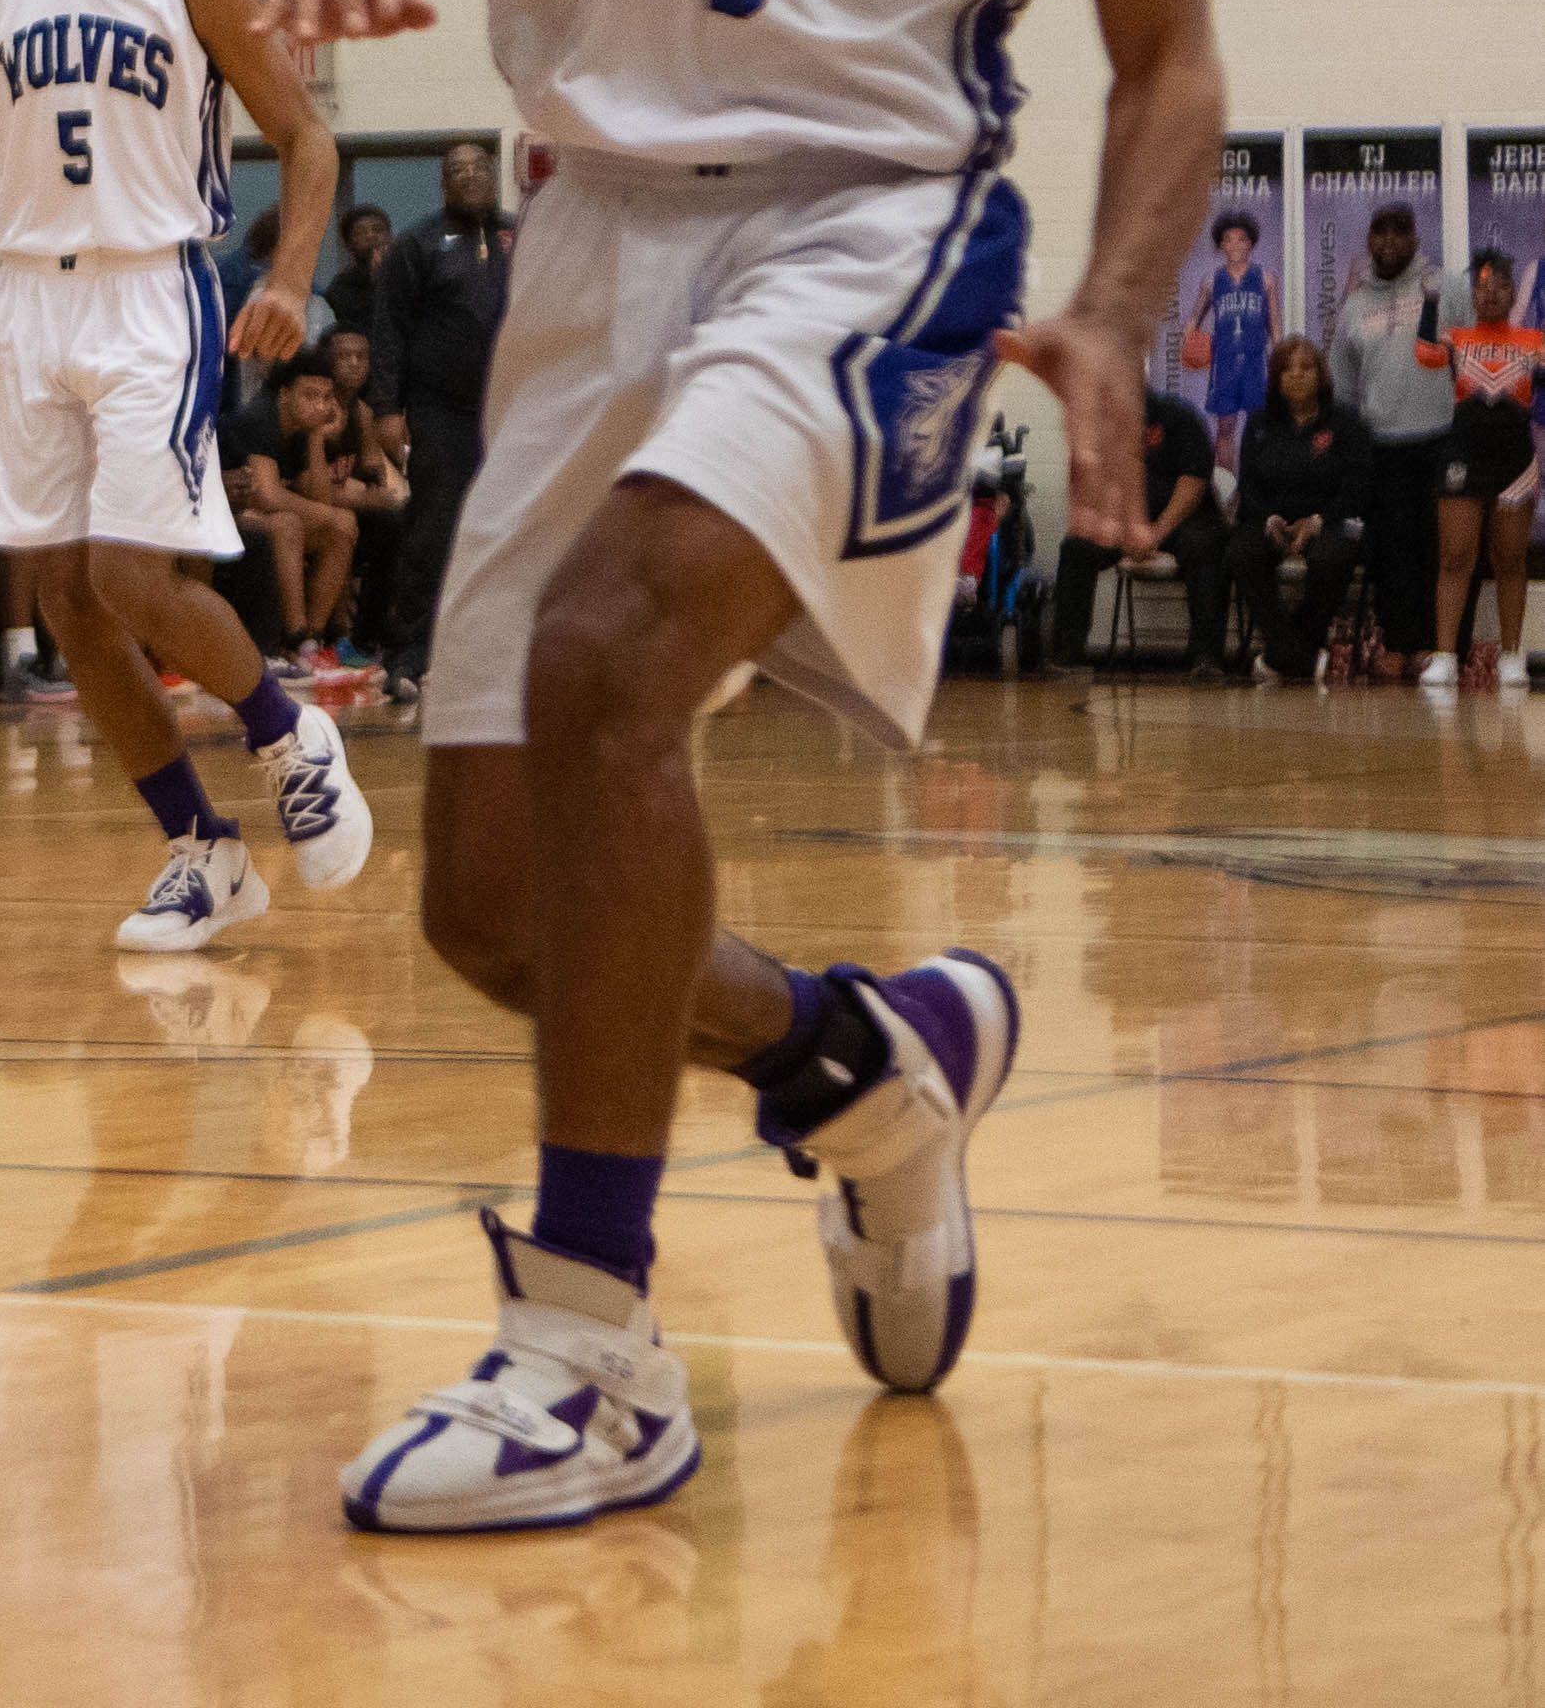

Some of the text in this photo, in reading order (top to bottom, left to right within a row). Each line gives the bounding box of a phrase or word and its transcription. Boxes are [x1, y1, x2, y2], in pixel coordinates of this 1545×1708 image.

[57, 109, 93, 186] 5
[1359, 144, 1386, 168] TJ
[1310, 170, 1438, 195] CHANDLER
